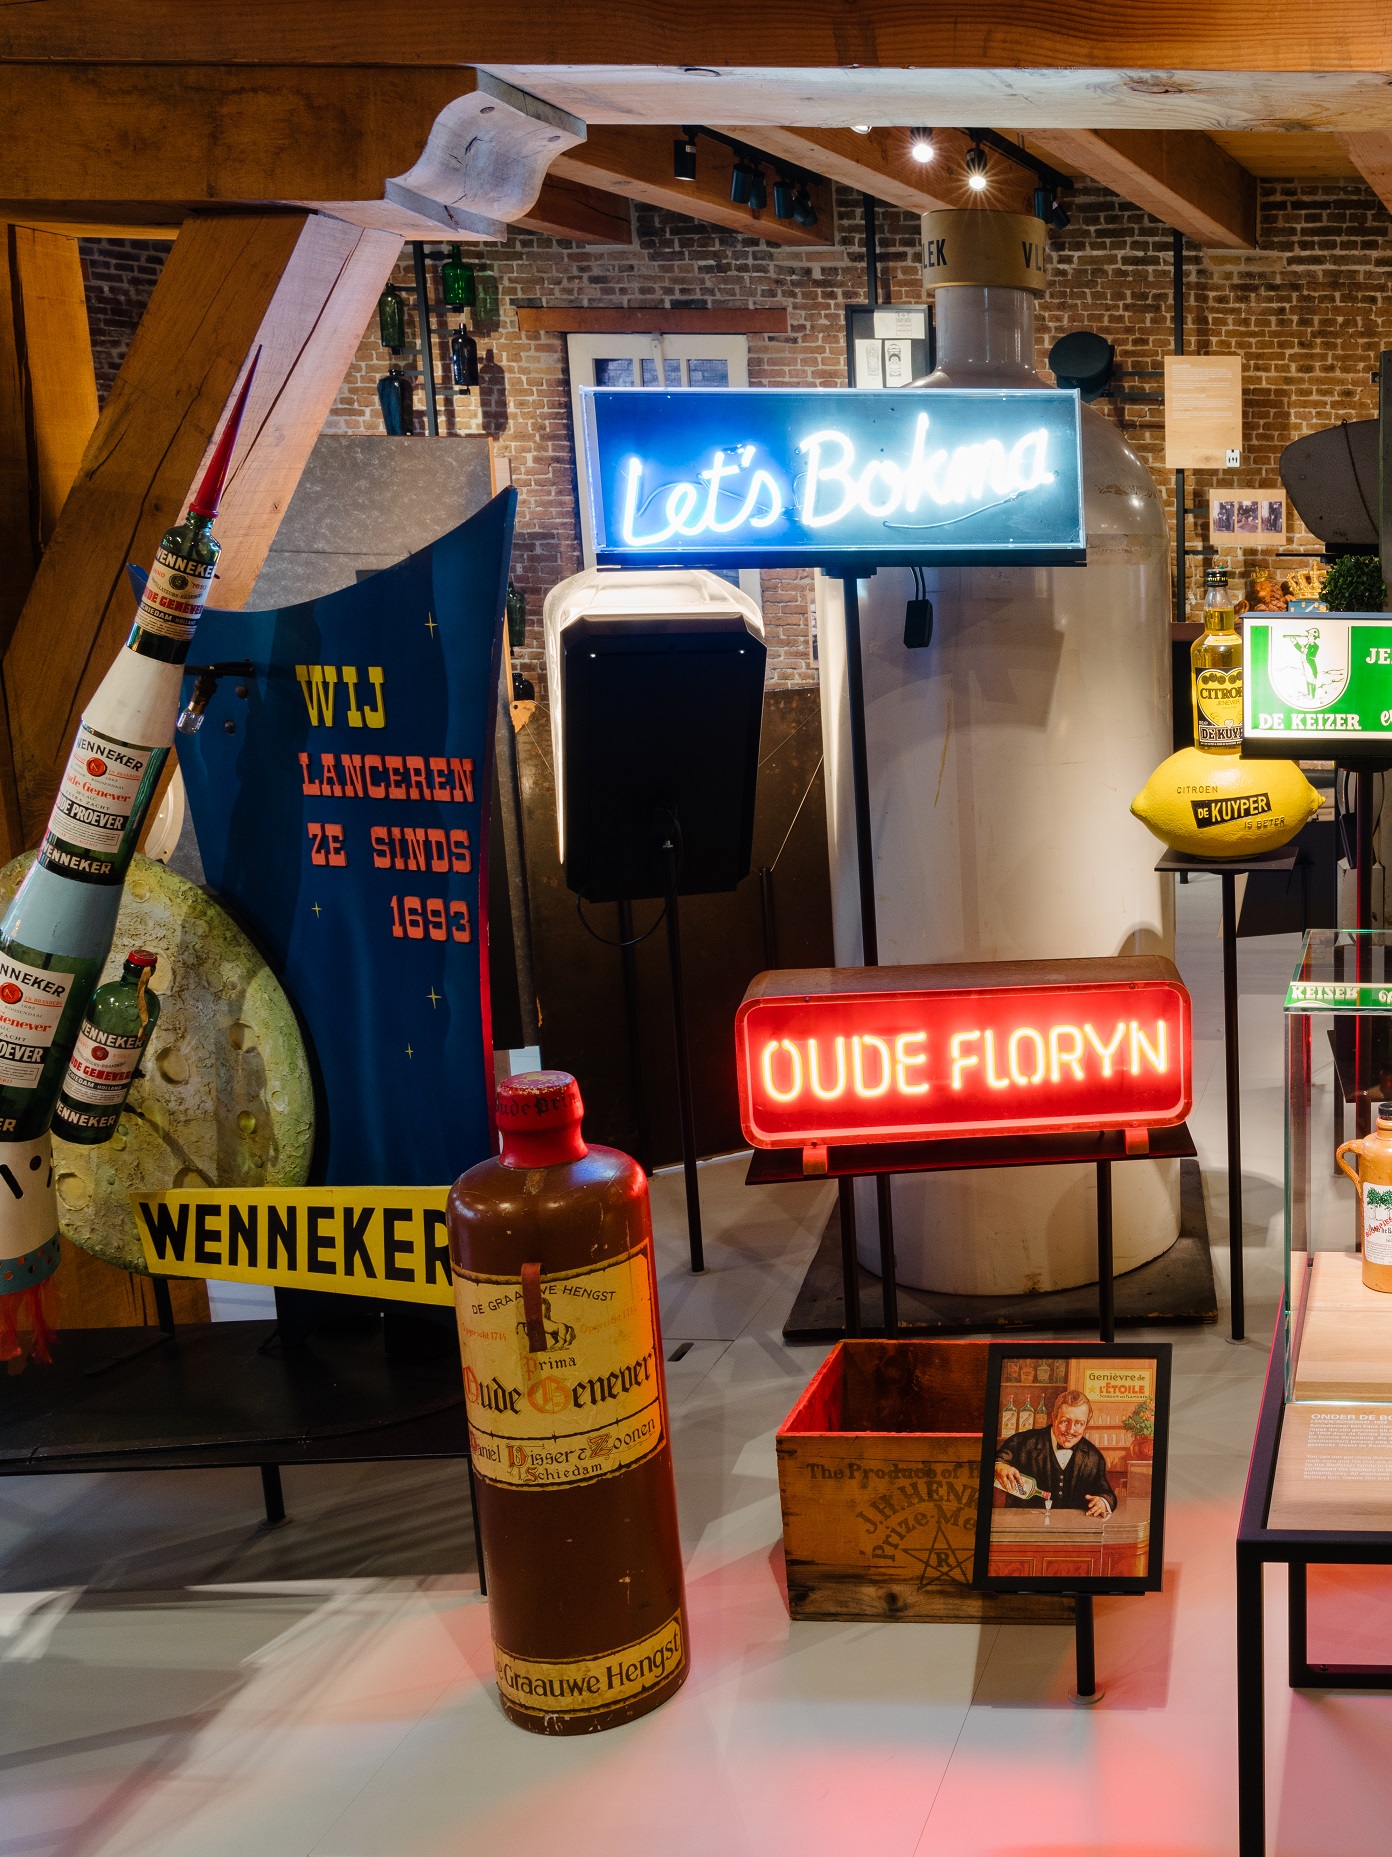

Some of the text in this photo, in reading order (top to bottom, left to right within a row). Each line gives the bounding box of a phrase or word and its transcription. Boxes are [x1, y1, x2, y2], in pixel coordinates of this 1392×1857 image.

[922, 238, 947, 270] LEK
[1021, 240, 1045, 272] VL
[622, 410, 1057, 547] Let's Bokma
[156, 547, 216, 579] ENNEKE
[295, 664, 387, 730] WIJ
[1258, 713, 1362, 731] DE KEIZER
[82, 781, 132, 802] Genever
[298, 752, 475, 803] LANCEREN
[1176, 785, 1219, 794] CITROEN
[71, 803, 124, 830] PROEVER
[1197, 796, 1269, 823] DE KUYPER
[1256, 816, 1286, 829] BETER
[307, 822, 473, 874] ZE SINDS
[390, 895, 472, 943] 1693
[761, 1019, 1169, 1103] OUDE FLORYN
[138, 1201, 455, 1287] WENNEKER
[472, 1284, 617, 1315] DE GRAAWE HENGST
[463, 1351, 654, 1415] Oude Genever
[523, 1355, 577, 1381] Prima
[1136, 1374, 1146, 1382] de
[1310, 1413, 1356, 1421] ONDER
[586, 1416, 657, 1461] Zoonen
[522, 1463, 602, 1483] Schiedam
[805, 1462, 844, 1480] The
[848, 1462, 937, 1480] Produce
[933, 1551, 952, 1568] R
[504, 1662, 601, 1698] Graauwe
[604, 1626, 681, 1692] Hengst
